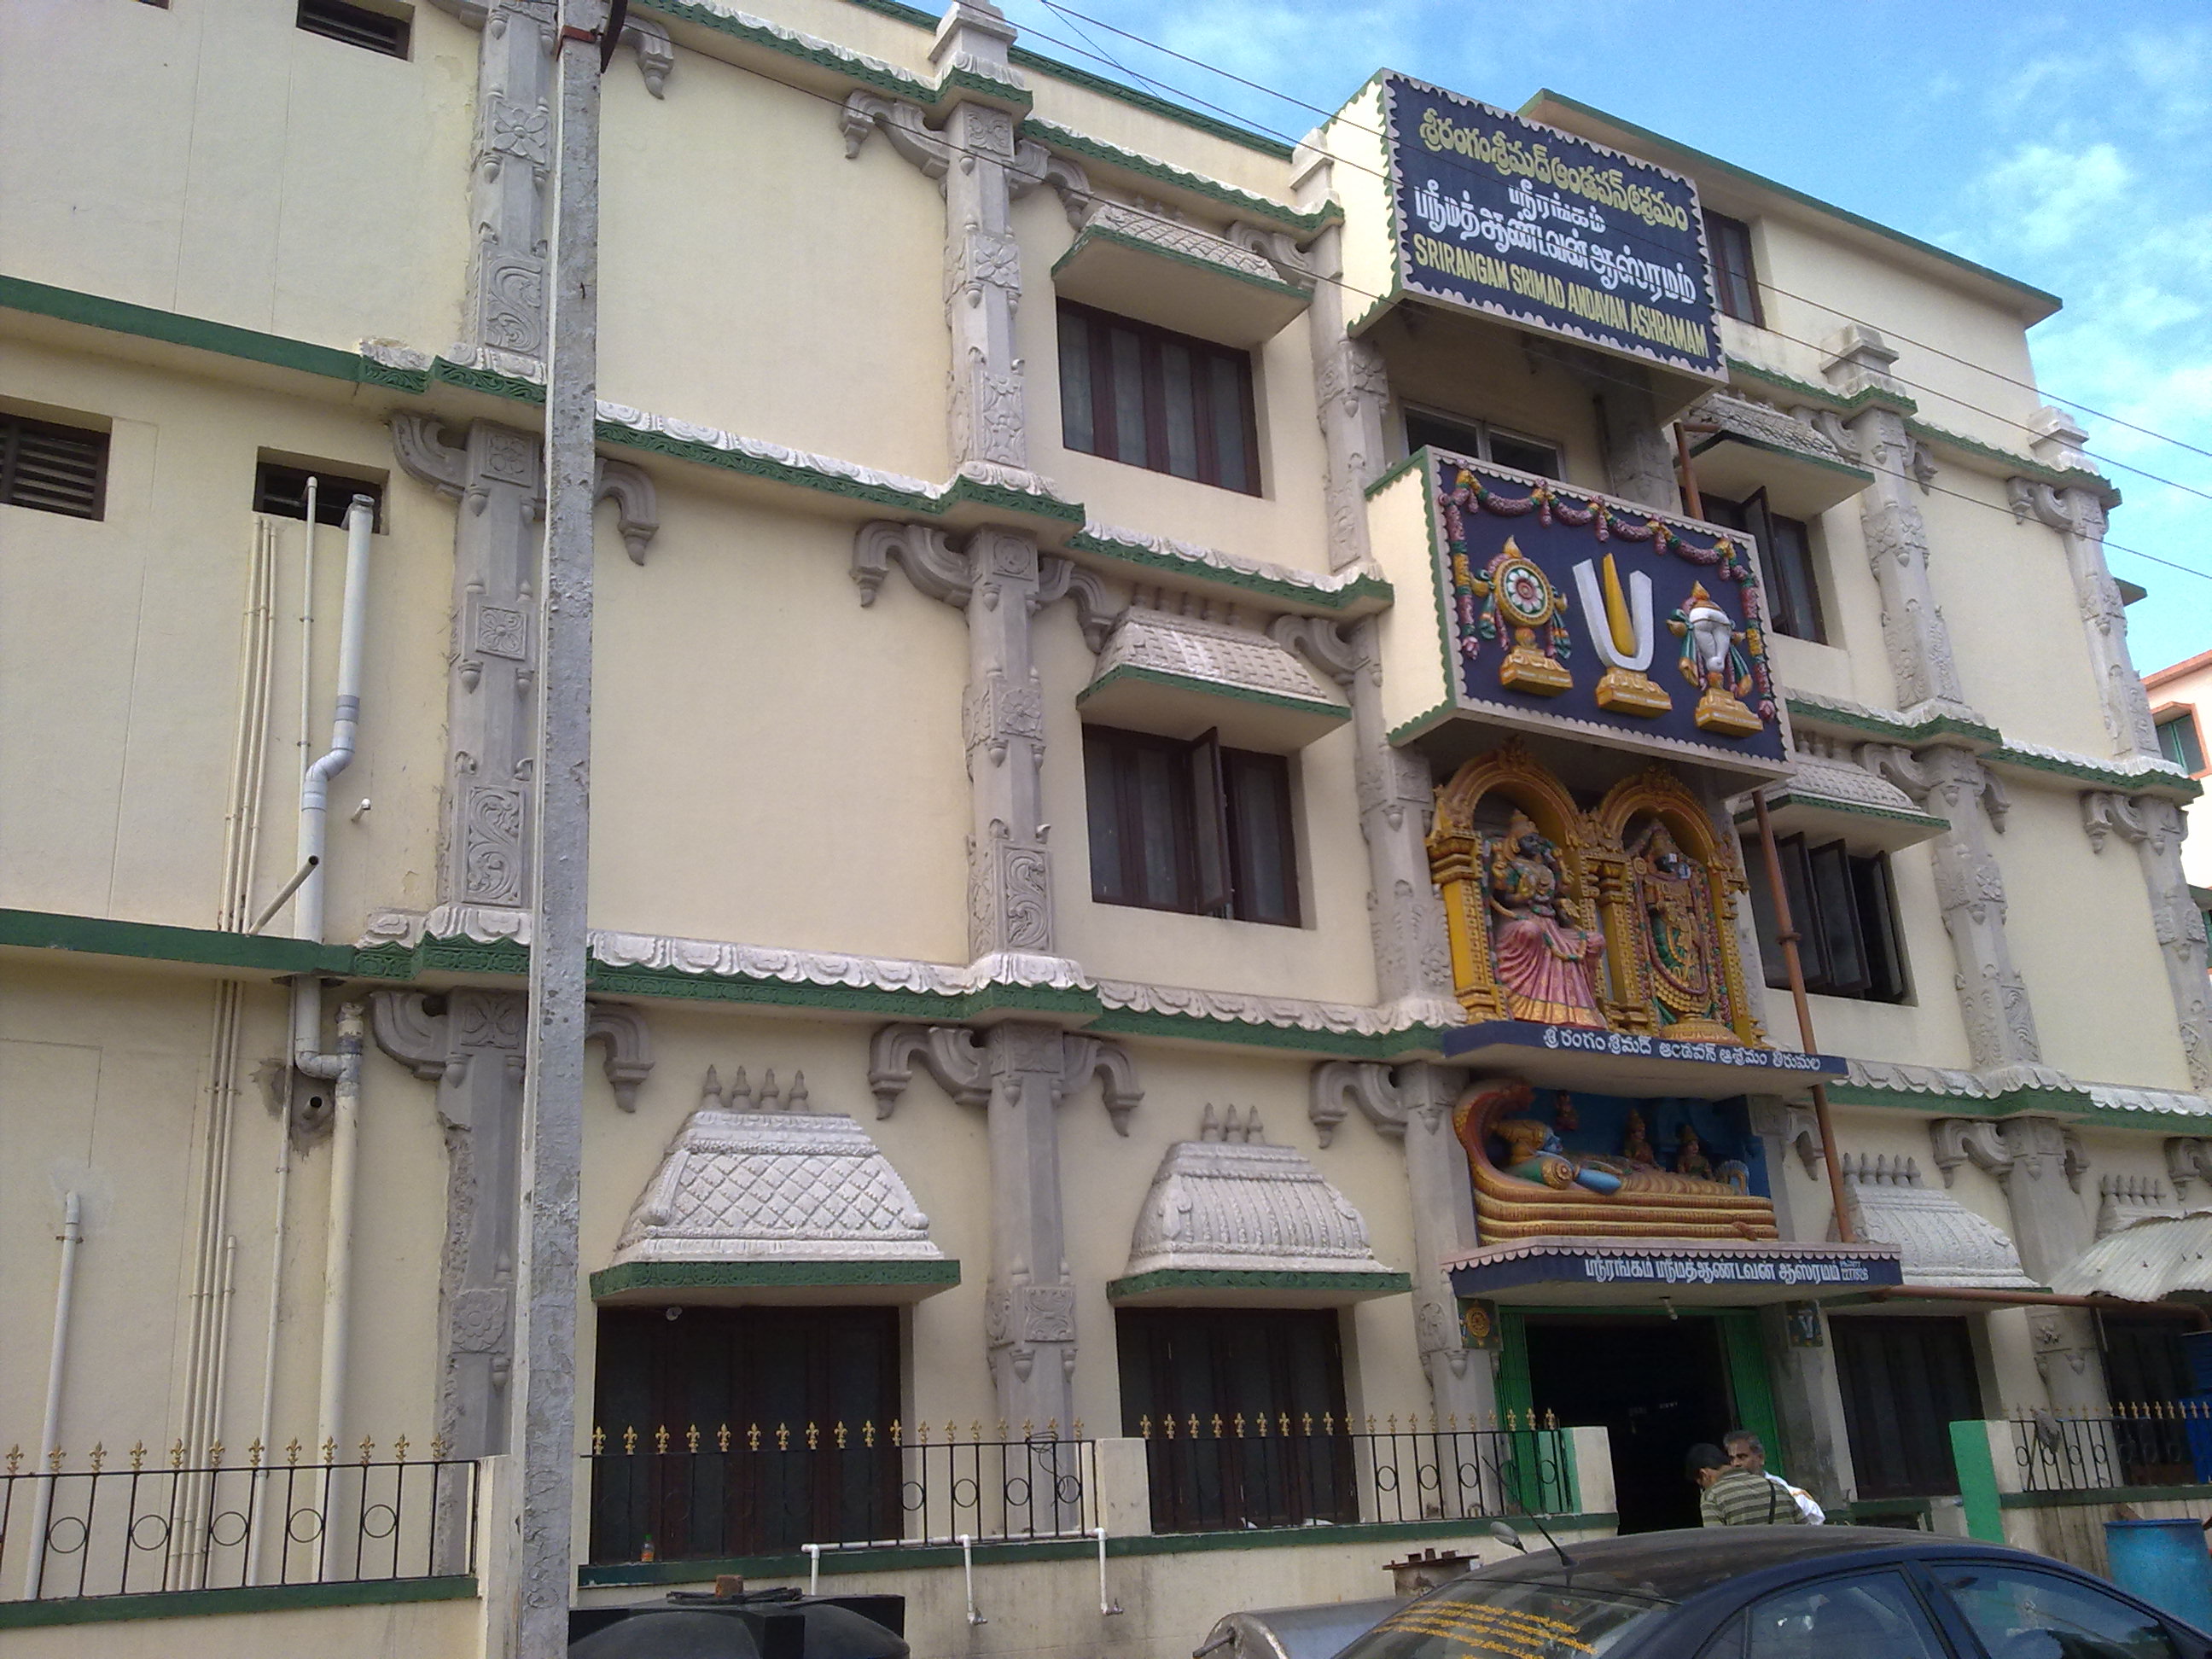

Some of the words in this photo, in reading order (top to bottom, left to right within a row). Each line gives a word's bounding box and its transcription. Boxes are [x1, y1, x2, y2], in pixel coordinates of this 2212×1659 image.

[1413, 233, 1511, 291] SRIRANGAM
[1510, 263, 1566, 310] SRIMAD
[1568, 282, 1630, 333] ANDAVAN
[1631, 301, 1710, 359] ASHRAMAM
